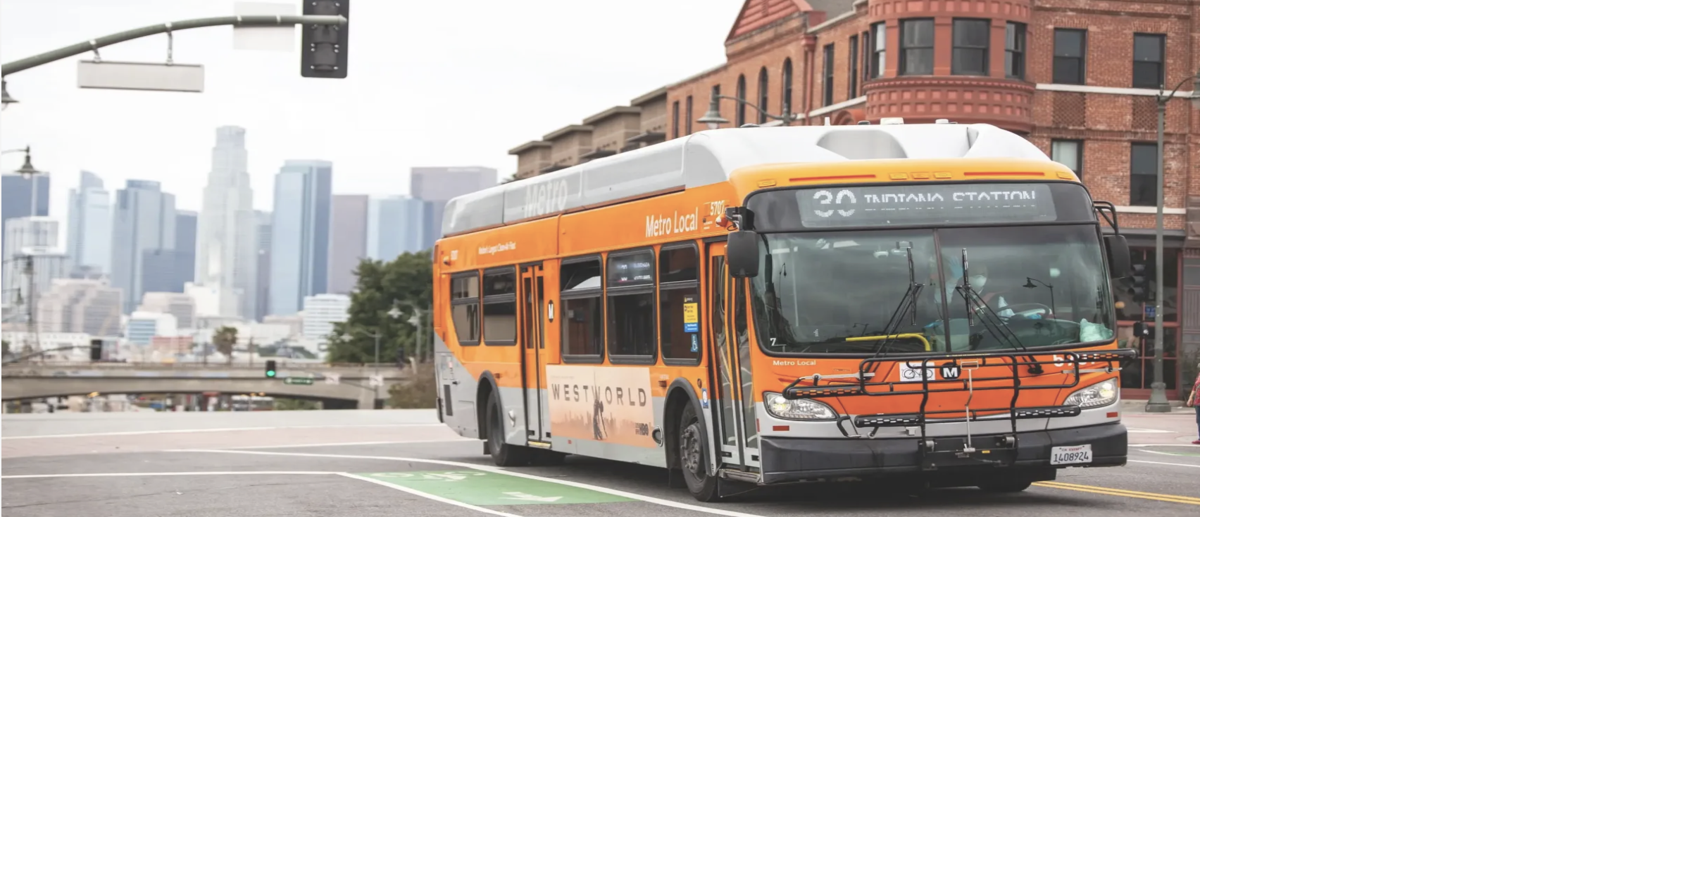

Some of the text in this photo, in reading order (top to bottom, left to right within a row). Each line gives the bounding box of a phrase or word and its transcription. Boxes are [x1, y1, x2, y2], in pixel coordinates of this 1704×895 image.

[524, 179, 568, 218] Metro
[813, 189, 857, 217] 30
[952, 190, 1036, 209] STATION
[645, 206, 699, 238] Metro Local
[942, 367, 958, 378] M
[551, 383, 648, 408] WESTWORLD
[1053, 451, 1089, 463] 1408924
